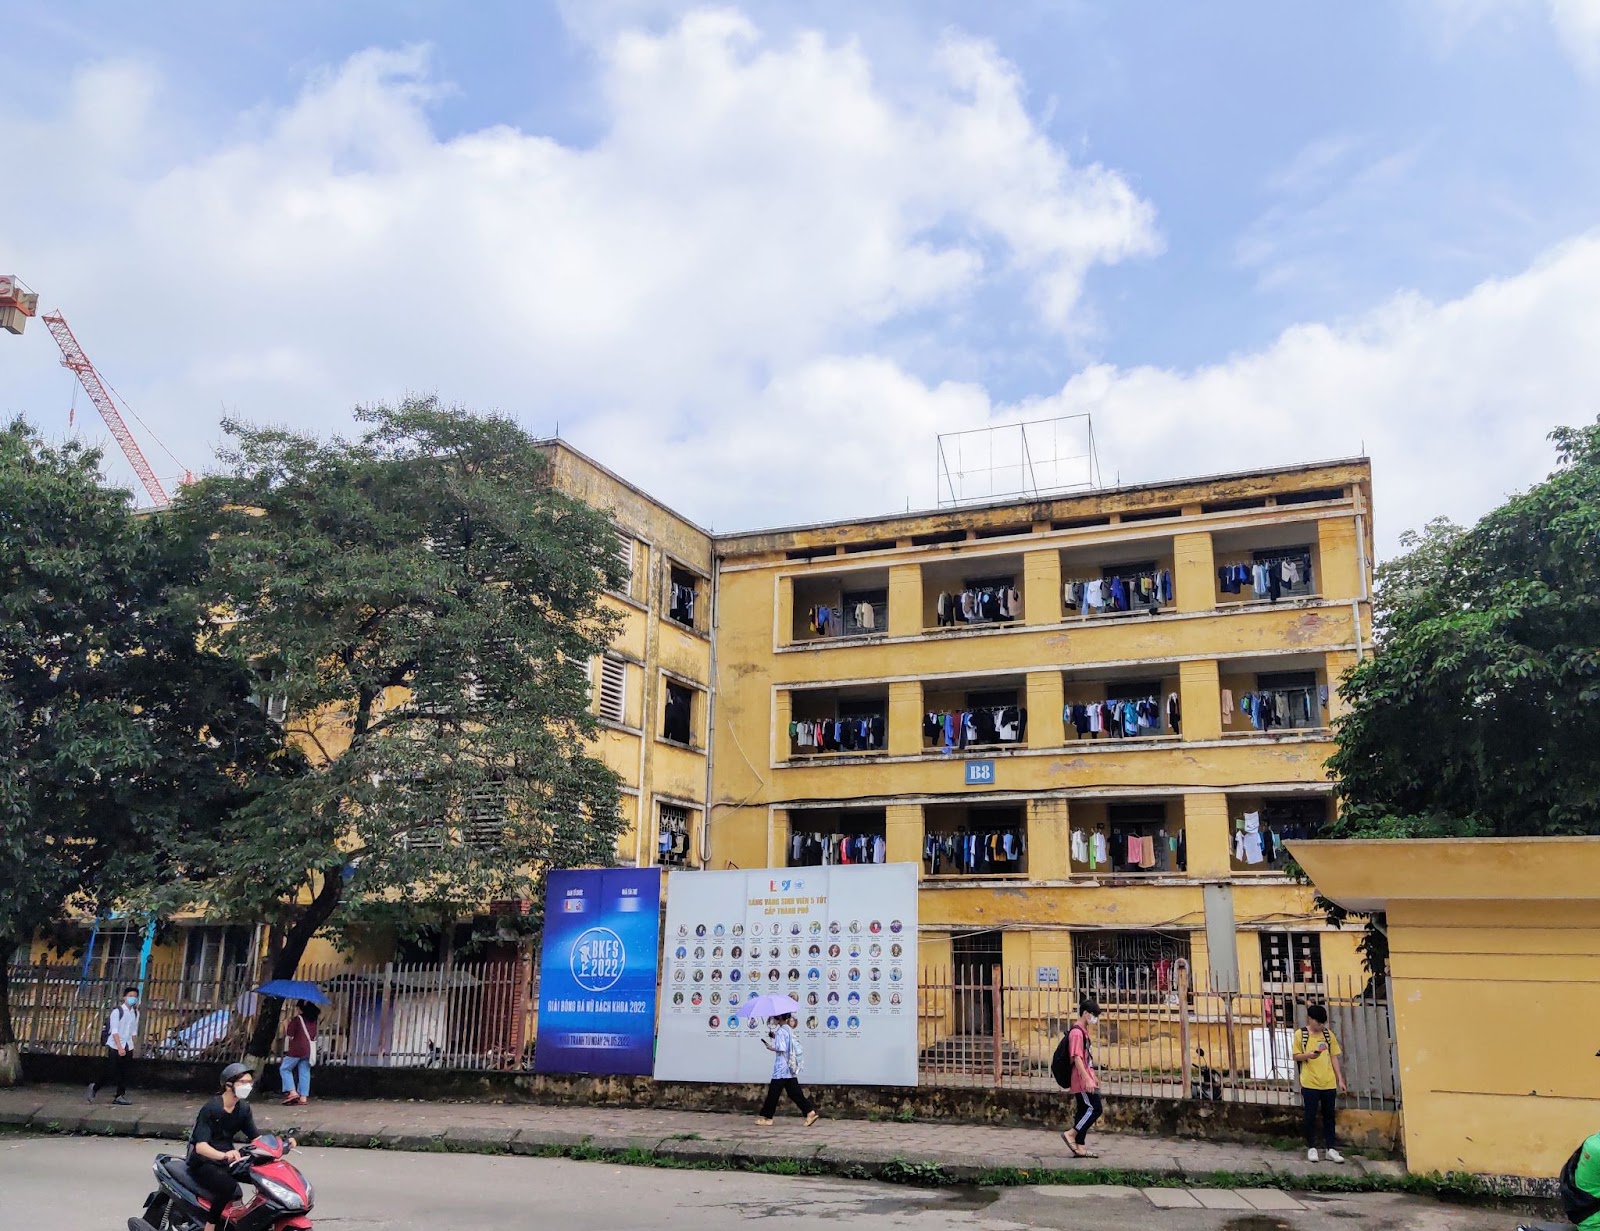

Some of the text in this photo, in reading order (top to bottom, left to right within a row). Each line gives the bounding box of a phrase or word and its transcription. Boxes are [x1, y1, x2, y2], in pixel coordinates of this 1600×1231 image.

[969, 765, 991, 780] B8
[781, 897, 795, 905] SINH
[592, 940, 619, 959] BKFS
[591, 958, 618, 977] 2022
[560, 999, 576, 1013] BÓNG
[595, 999, 611, 1012] BÁCH
[612, 1000, 629, 1013] KHOA
[629, 1001, 646, 1013] 2022
